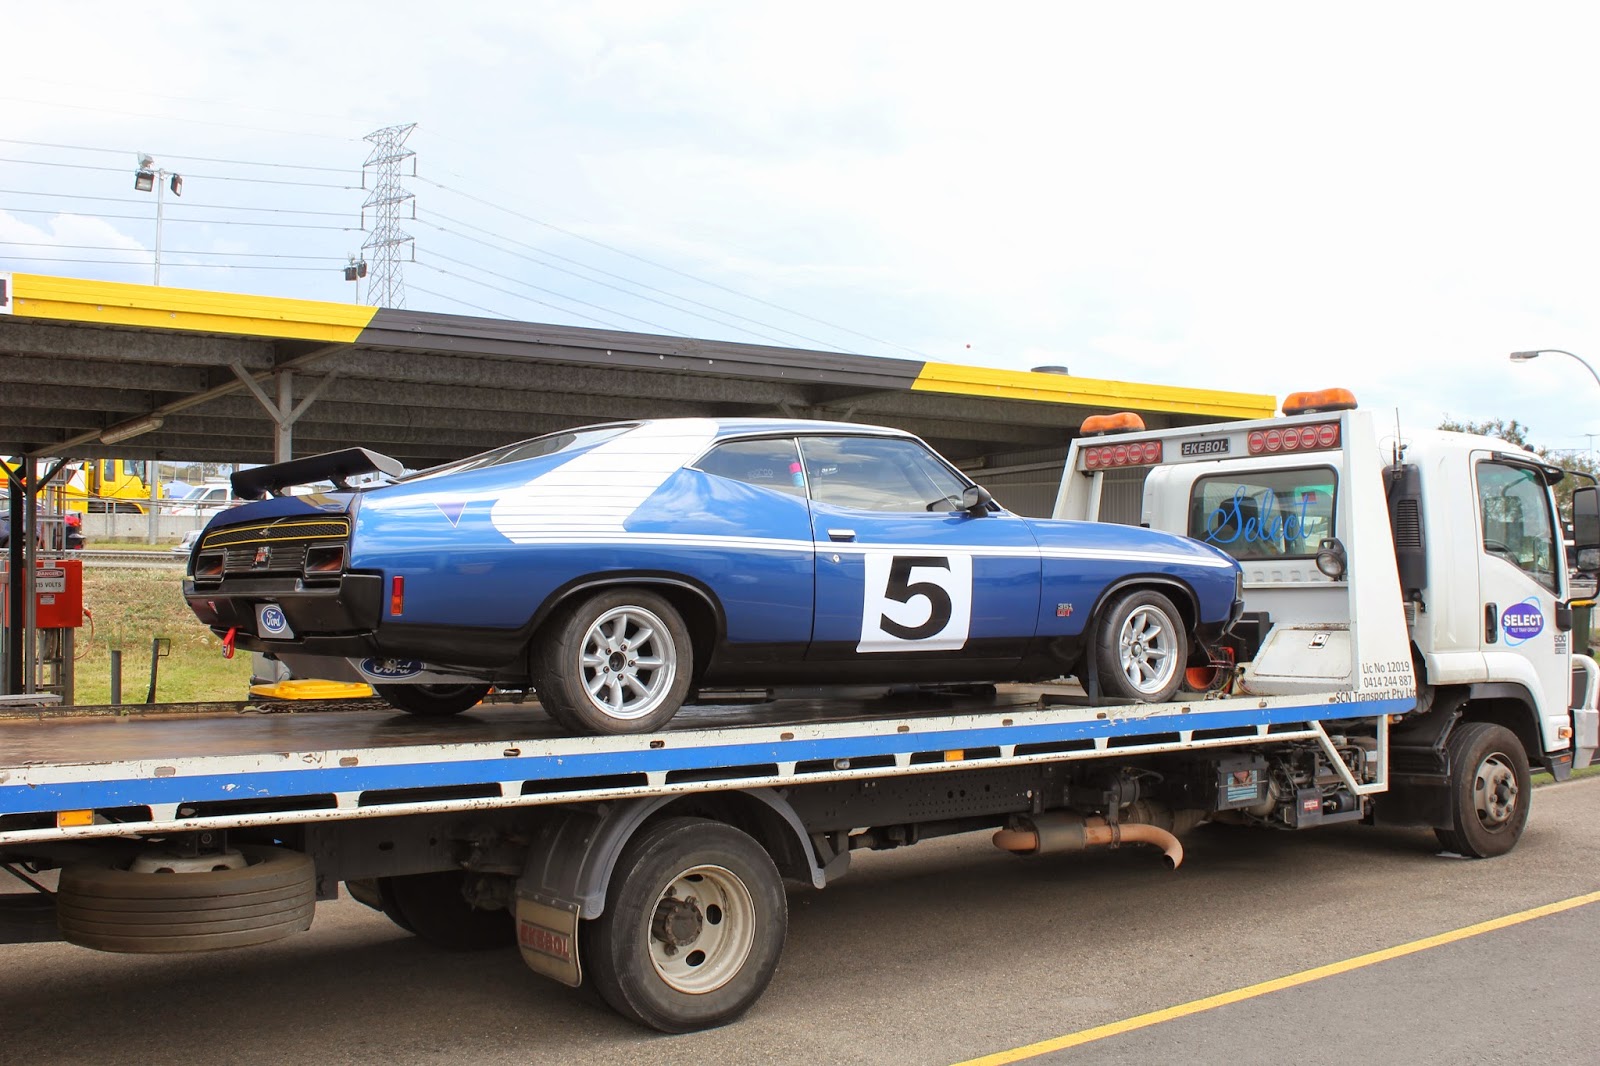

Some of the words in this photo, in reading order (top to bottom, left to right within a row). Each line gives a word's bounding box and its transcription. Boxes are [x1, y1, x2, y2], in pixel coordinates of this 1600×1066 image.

[1183, 441, 1226, 455] EKEBOL
[1204, 486, 1317, 543] Select
[880, 556, 952, 640] 5
[267, 610, 281, 627] Ford
[1504, 614, 1541, 626] SELECT
[1362, 663, 1373, 674] Lic
[1374, 662, 1385, 672] No
[1387, 661, 1410, 672] 12019
[1363, 676, 1382, 688] 0414
[1384, 676, 1398, 687] 244
[1399, 675, 1412, 686] 887
[1335, 691, 1351, 703] SCN
[1354, 690, 1390, 703] Transport
[1392, 688, 1404, 700] Pty
[520, 923, 570, 960] EKEBOL
